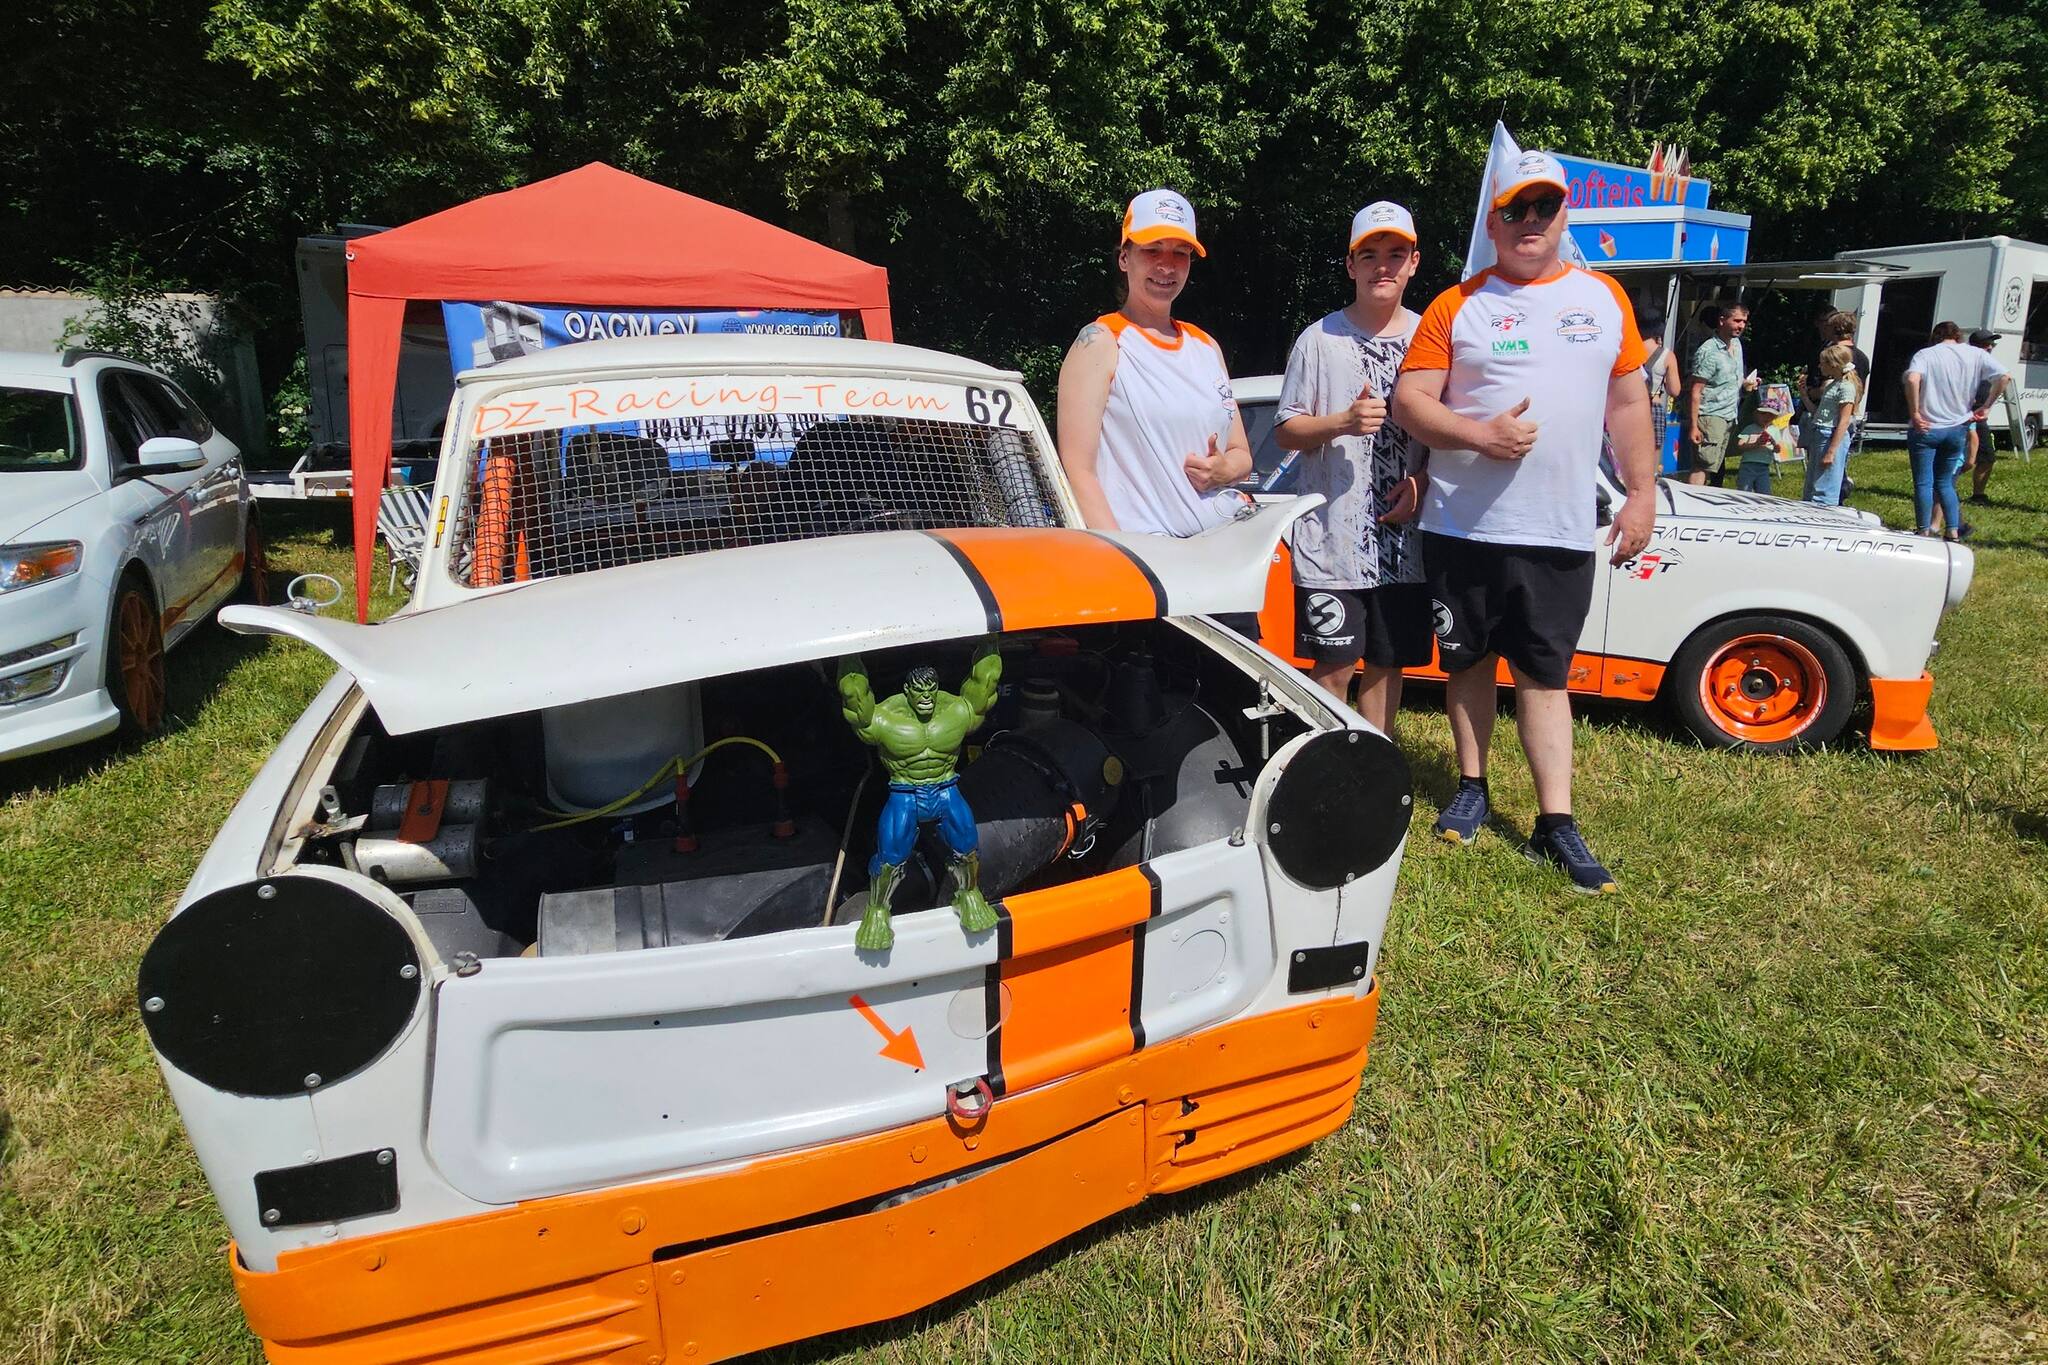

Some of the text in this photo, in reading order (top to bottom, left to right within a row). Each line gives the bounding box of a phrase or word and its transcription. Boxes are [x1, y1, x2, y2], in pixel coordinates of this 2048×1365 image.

[1563, 167, 1645, 209] ofteis
[563, 311, 652, 340] OACM
[744, 321, 837, 335] www.oacm.info
[1492, 341, 1519, 352] LVM
[473, 383, 950, 438] DZ-Racing-Team
[965, 386, 1017, 429] 62
